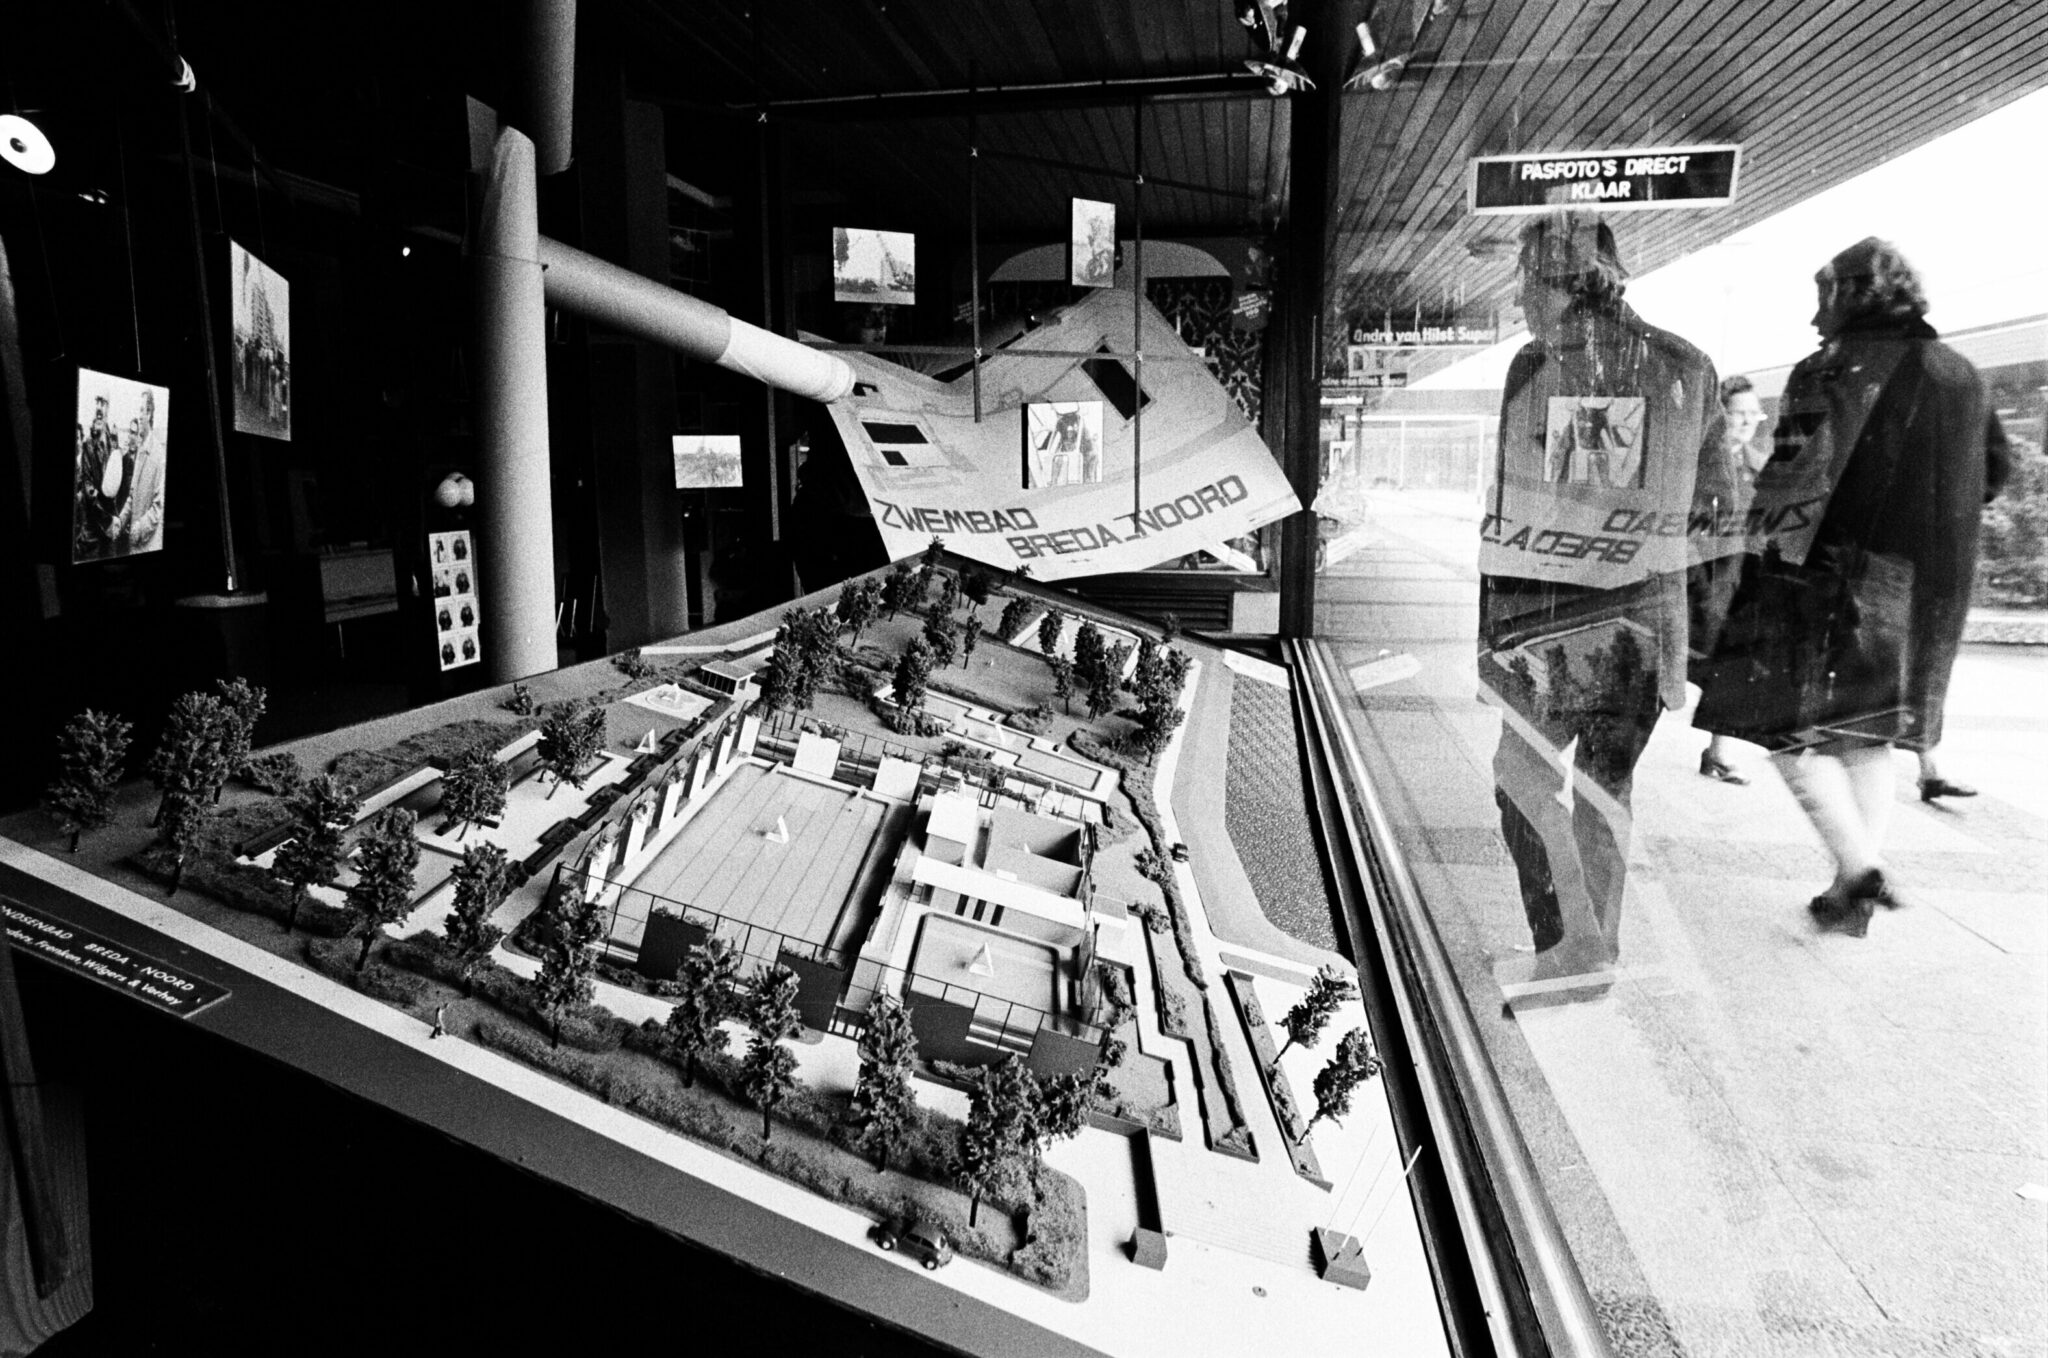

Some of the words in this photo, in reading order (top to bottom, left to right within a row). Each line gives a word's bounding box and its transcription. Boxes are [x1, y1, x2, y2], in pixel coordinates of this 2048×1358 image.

[1520, 159, 1617, 181] PASFOTO'S
[1624, 155, 1690, 177] DIRECT
[1570, 180, 1631, 200] KLAAR
[1396, 331, 1421, 343] van
[873, 498, 1038, 534] ZWEMBAD
[1006, 522, 1123, 559] BREDA
[2, 905, 74, 940] NDSENBAD
[83, 943, 130, 965] BREDA
[140, 965, 195, 992] NOORD
